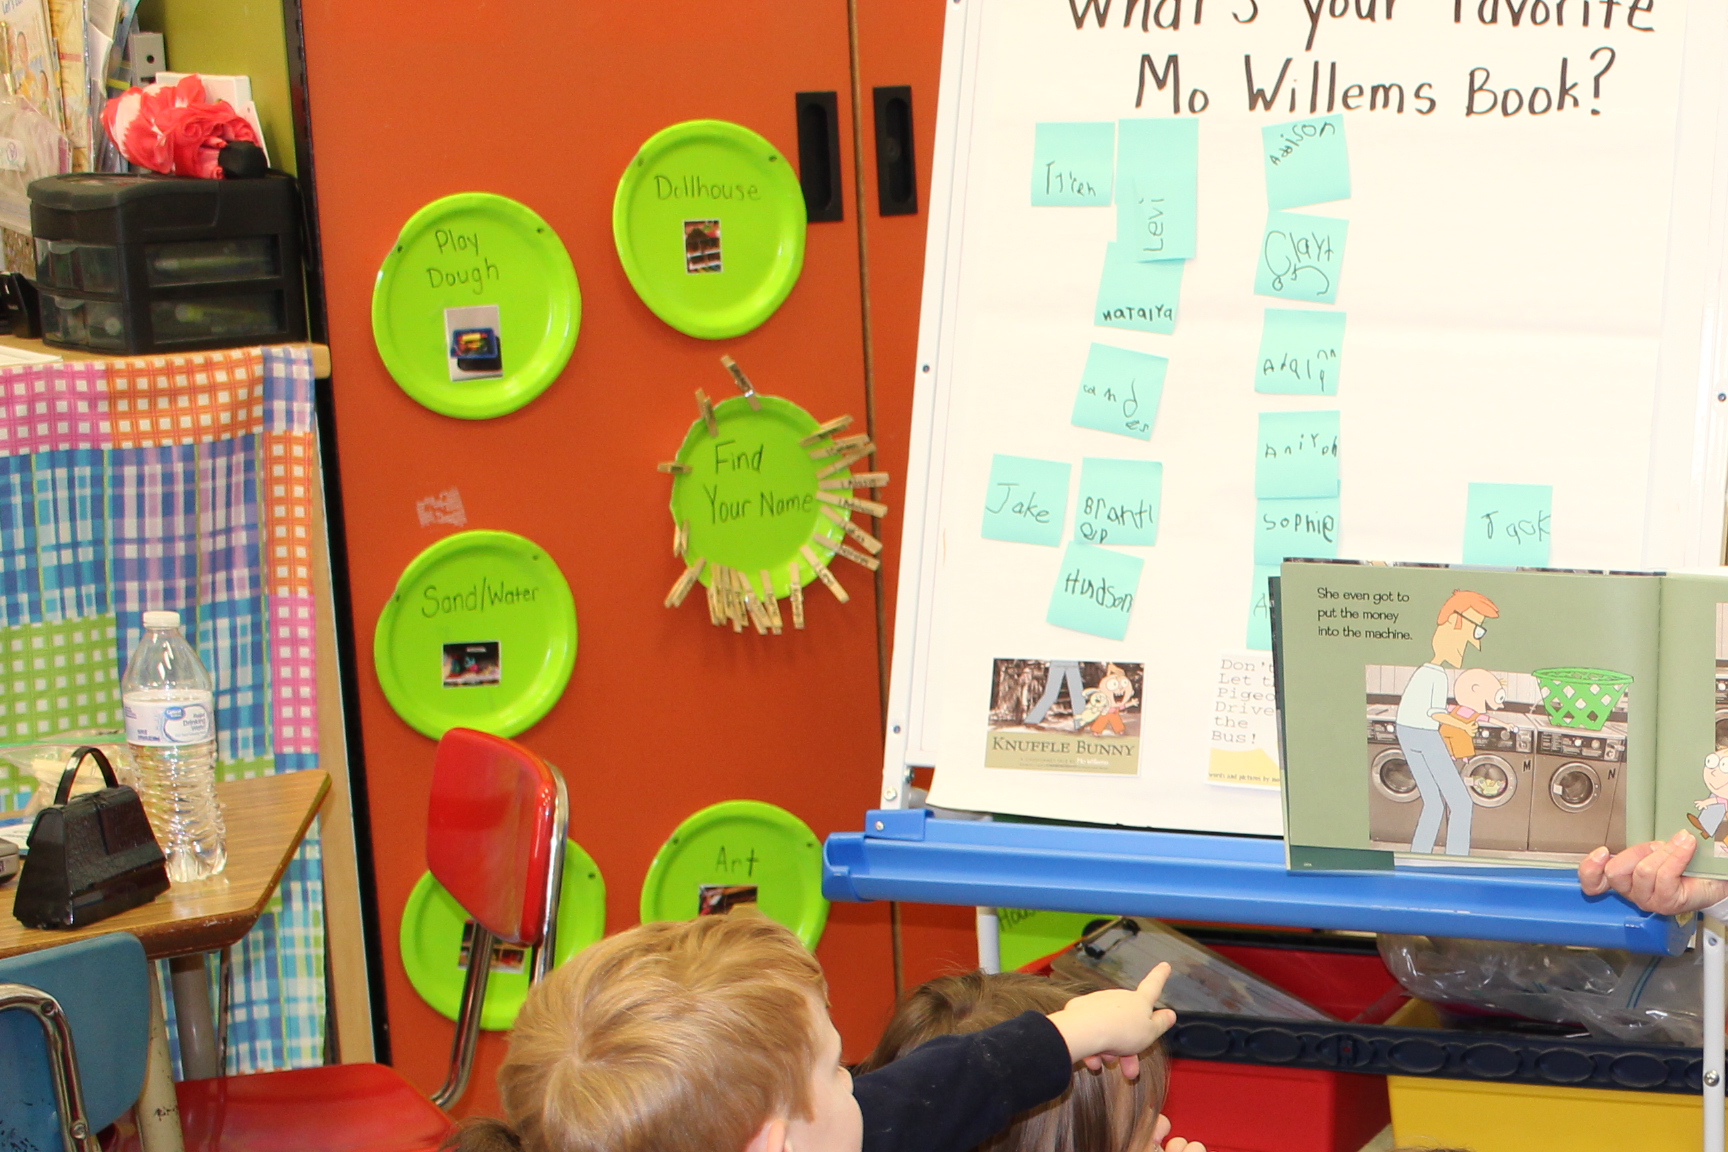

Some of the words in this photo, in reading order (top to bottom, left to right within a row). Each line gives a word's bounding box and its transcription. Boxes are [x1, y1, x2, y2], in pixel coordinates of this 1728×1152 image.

[1304, 0, 1395, 52] your
[1135, 53, 1210, 116] Mo
[1244, 54, 1437, 115] Willems
[1465, 46, 1616, 117] Book?
[654, 175, 761, 201] Dollhouse
[1138, 197, 1165, 253] Levi
[435, 229, 480, 256] Play
[426, 258, 501, 295] Dough
[714, 440, 764, 474] Find
[703, 484, 752, 524] Your
[760, 491, 814, 517] Name
[985, 482, 1051, 524] Jake
[421, 576, 539, 619] Sand/Water
[1317, 587, 1339, 600] She
[1343, 591, 1370, 601] even
[1373, 591, 1394, 605] got
[1397, 592, 1410, 602] to
[1318, 607, 1337, 621] put
[1340, 607, 1359, 619] the
[1362, 611, 1399, 624] money
[1318, 626, 1339, 636] into
[1342, 625, 1361, 637] the
[1365, 627, 1413, 640] machine.
[1218, 673, 1252, 686] Let
[1217, 687, 1276, 703] Pigeo
[1215, 701, 1275, 717] Drive
[1214, 716, 1249, 729] the
[992, 736, 1070, 753] KNUFFLE
[1077, 740, 1135, 757] BUNNY
[1211, 730, 1257, 744] Bus!
[1523, 760, 1532, 773] M
[1607, 768, 1617, 780] N
[715, 845, 759, 876] Art
